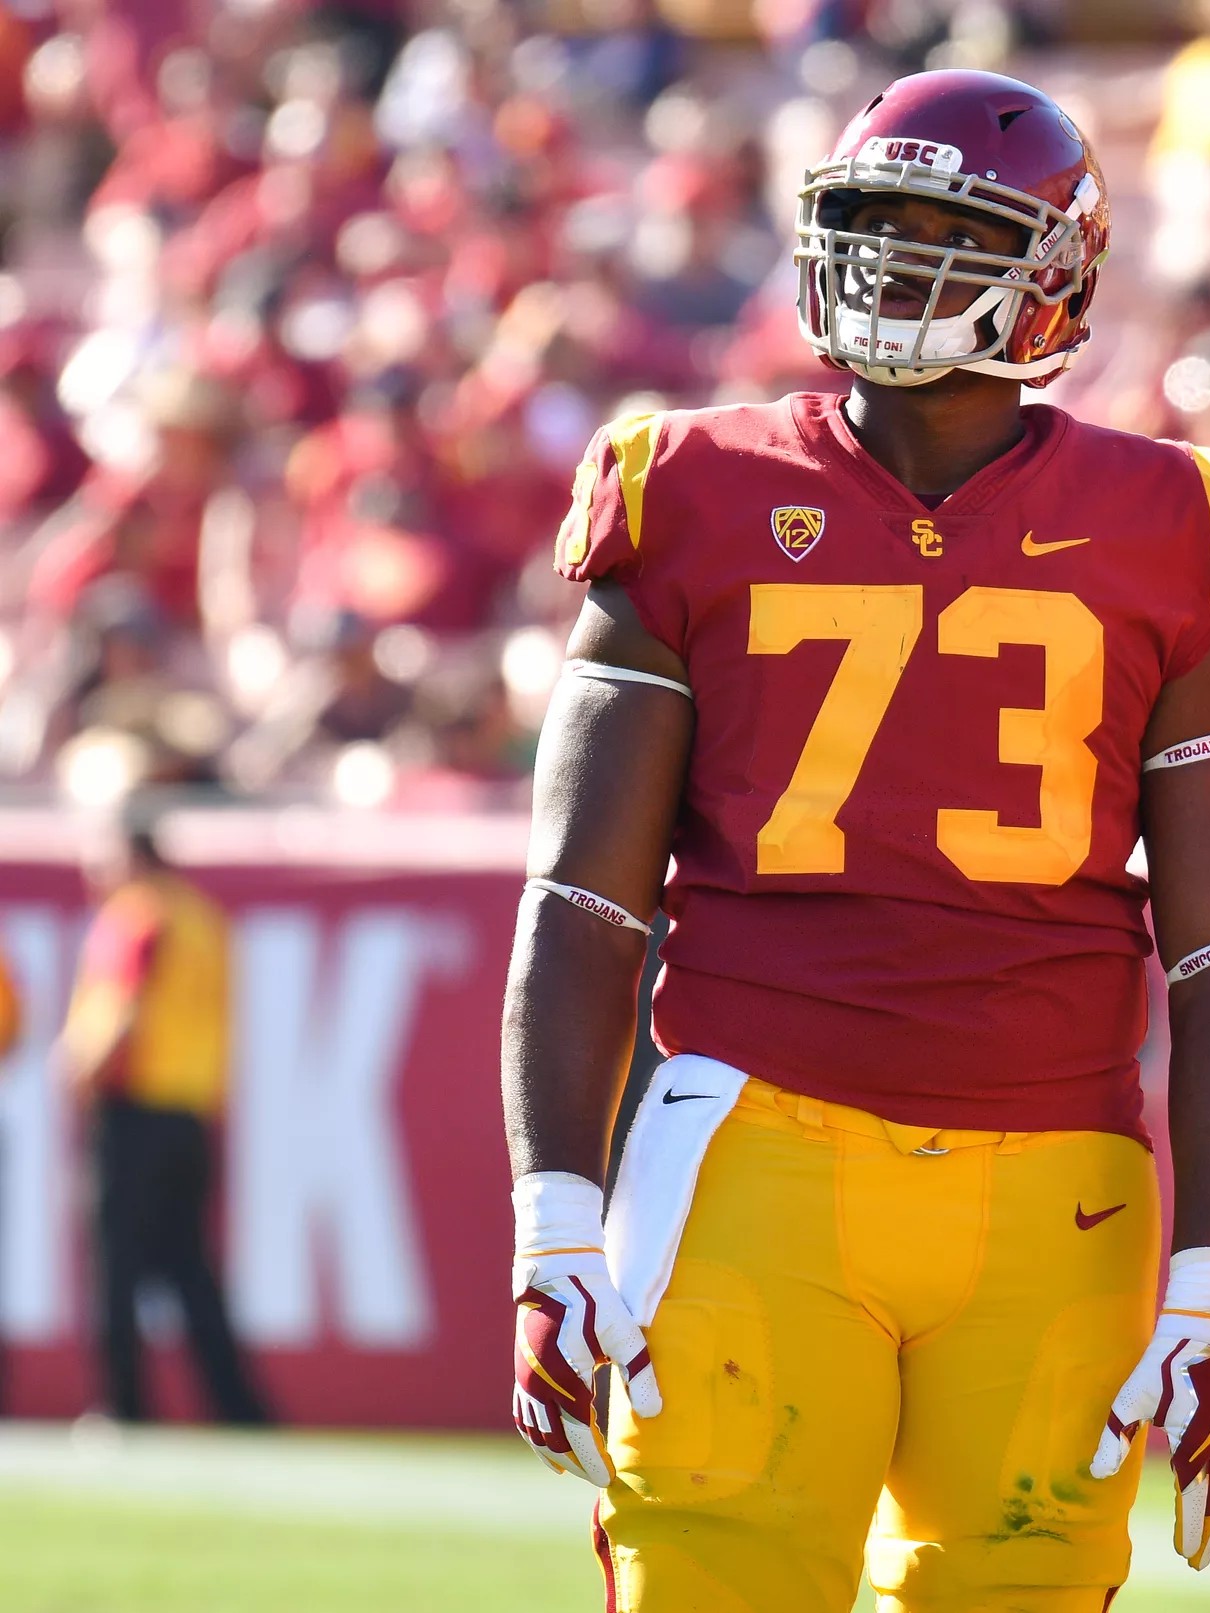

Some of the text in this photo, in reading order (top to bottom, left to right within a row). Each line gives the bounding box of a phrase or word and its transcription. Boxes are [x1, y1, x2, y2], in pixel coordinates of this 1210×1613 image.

[885, 141, 939, 167] USC
[1041, 232, 1058, 254] ON!
[854, 336, 903, 352] FIGT ON!
[774, 508, 822, 538] PAC
[785, 529, 810, 548] 12
[747, 583, 1104, 886] 73
[569, 890, 627, 925] TROJANS
